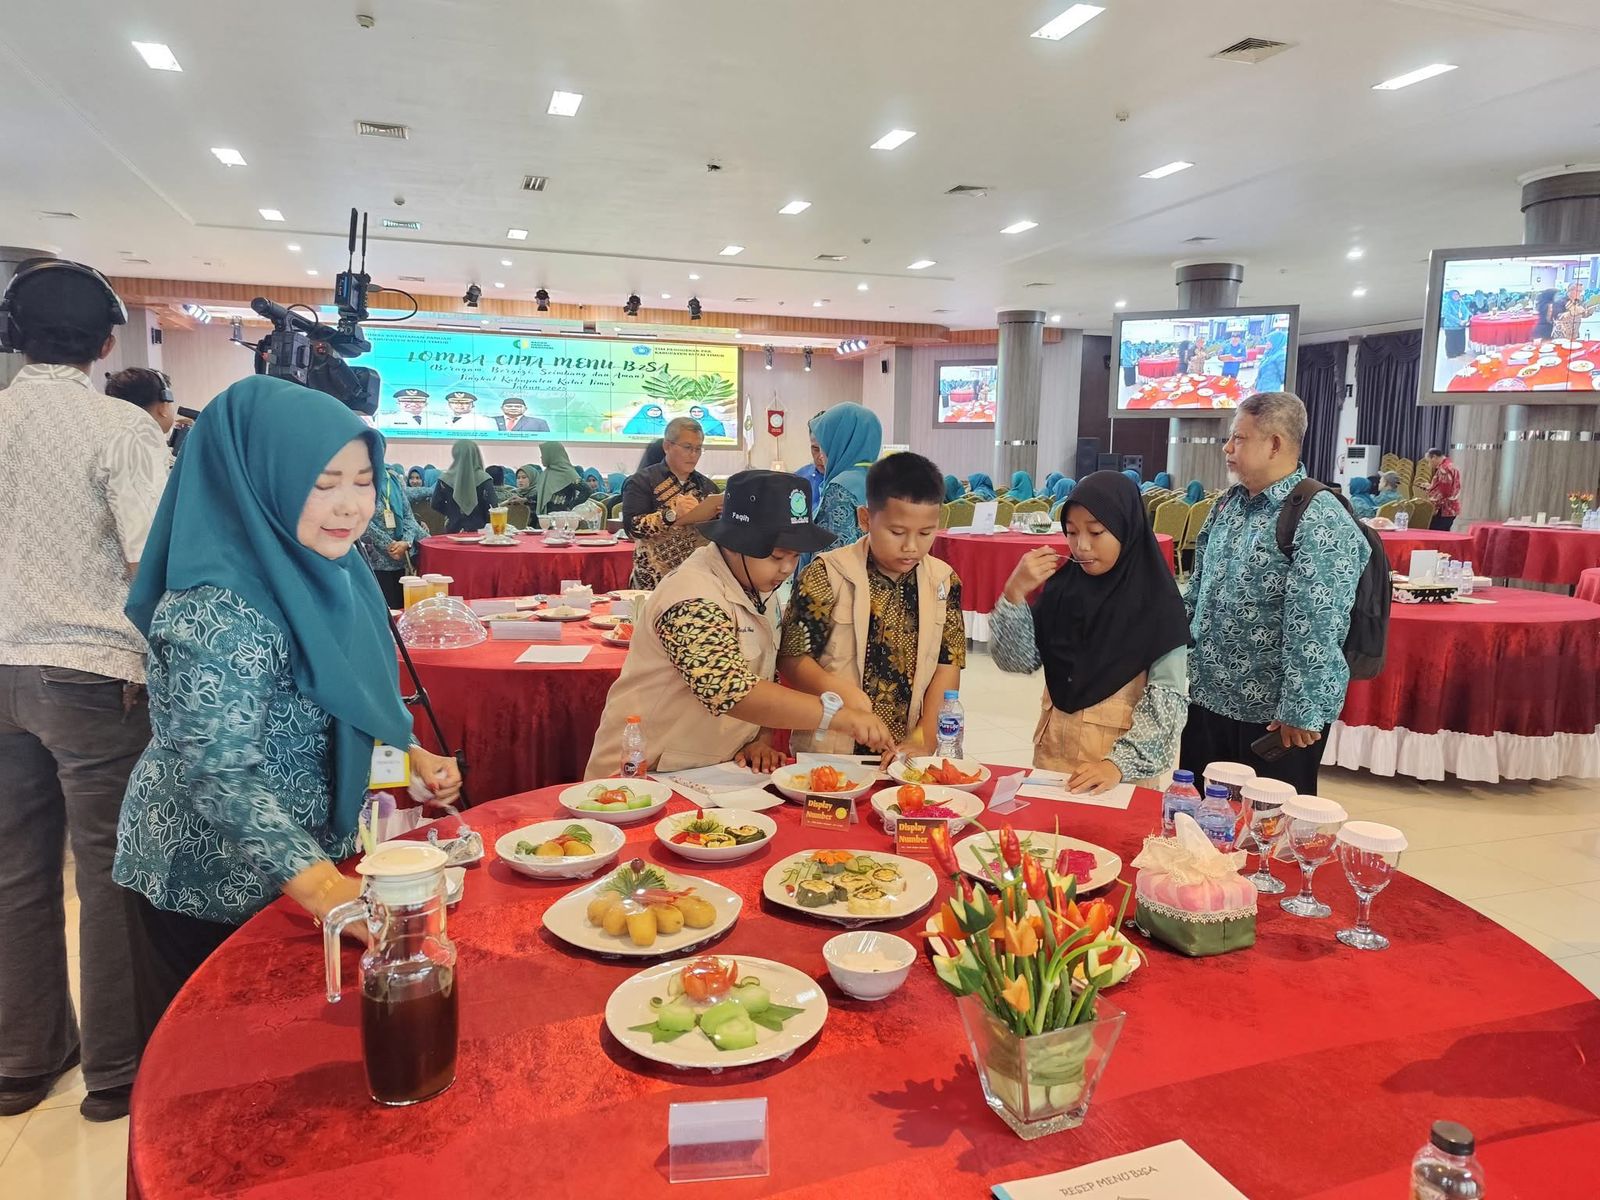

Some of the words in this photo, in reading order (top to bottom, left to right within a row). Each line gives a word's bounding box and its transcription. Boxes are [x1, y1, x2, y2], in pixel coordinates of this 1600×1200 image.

[408, 350, 485, 367] LOMBA
[496, 354, 544, 369] CIPTA
[553, 356, 614, 370] MENU
[501, 375, 553, 386] Kabupaten
[589, 378, 615, 387] Timur
[512, 382, 541, 391] Tahun
[731, 511, 750, 523] Faqih
[807, 799, 834, 811] Display
[805, 811, 833, 821] Number
[898, 822, 927, 834] Display
[898, 835, 929, 844] Number
[1059, 1181, 1095, 1197] RESEP
